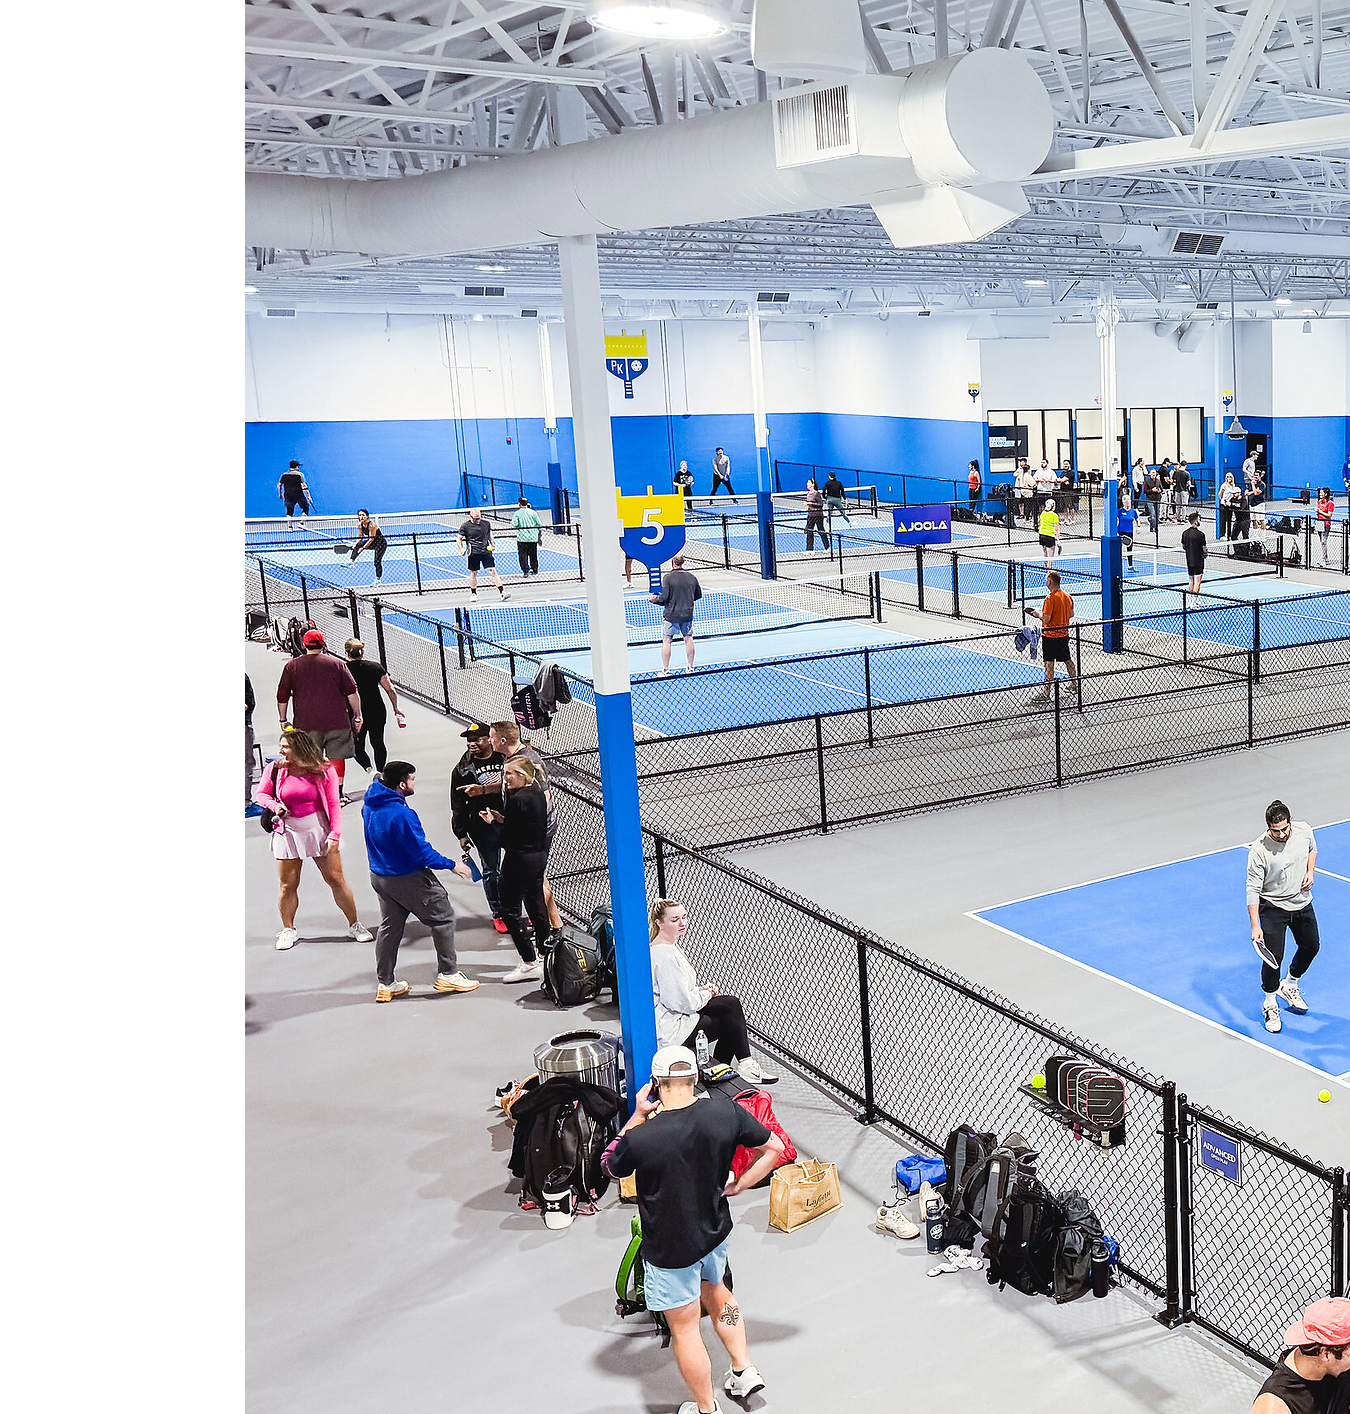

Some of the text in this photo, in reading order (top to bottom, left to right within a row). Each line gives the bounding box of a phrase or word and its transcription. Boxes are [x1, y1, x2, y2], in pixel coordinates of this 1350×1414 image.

[611, 360, 624, 375] PK
[640, 508, 665, 546] 5
[907, 520, 948, 532] JOOLA
[1202, 1141, 1236, 1163] ADVANCED
